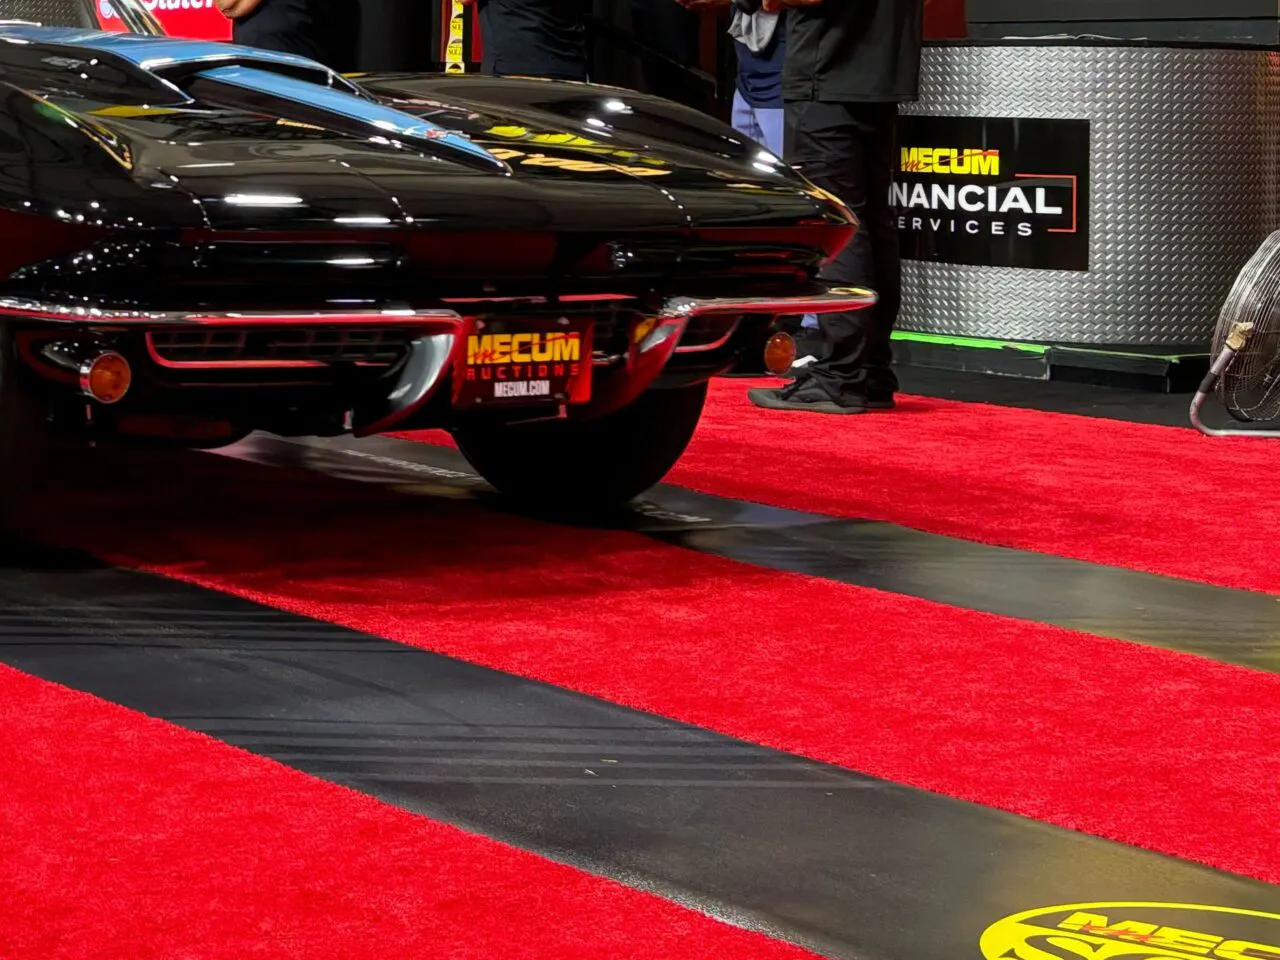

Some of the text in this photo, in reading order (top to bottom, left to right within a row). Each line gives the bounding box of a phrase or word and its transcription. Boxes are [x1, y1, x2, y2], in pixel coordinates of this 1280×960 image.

[900, 147, 1000, 176] MECUM
[897, 216, 1033, 237] ERVICES
[467, 332, 581, 365] MECUM
[493, 380, 551, 398] MECUM.COM
